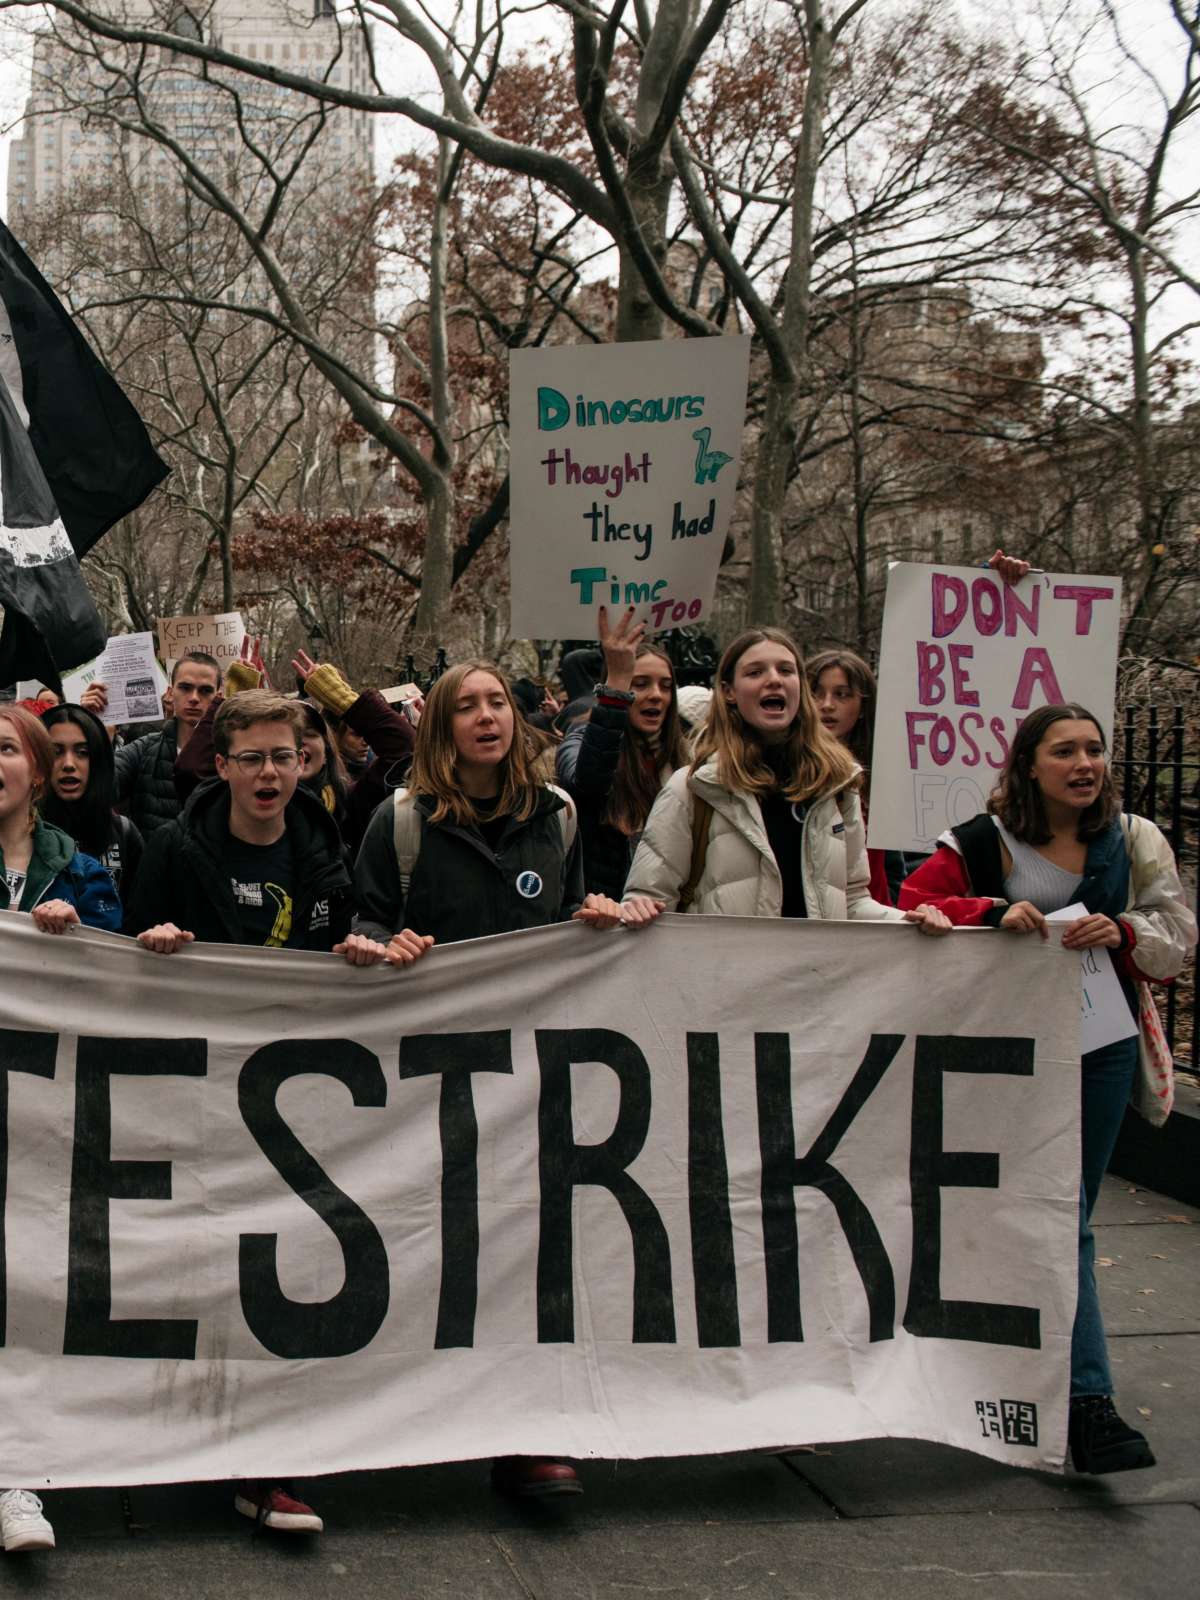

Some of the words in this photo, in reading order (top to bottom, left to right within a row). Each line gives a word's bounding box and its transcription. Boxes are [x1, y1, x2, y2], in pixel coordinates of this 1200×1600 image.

[537, 386, 705, 432] Dinosaurs
[582, 501, 653, 561] they
[671, 498, 716, 541] had
[570, 567, 668, 605] Time
[931, 572, 1114, 638] DON'T
[162, 620, 204, 641] KEEP
[211, 620, 237, 636] THE
[651, 598, 702, 628] TOO
[916, 640, 981, 707] BE
[1011, 647, 1066, 710] A
[904, 711, 1027, 770] FOSS
[913, 773, 987, 838] FO
[974, 1400, 998, 1418] AS
[1003, 1403, 1033, 1423] AS
[1007, 1420, 1035, 1442] 19
